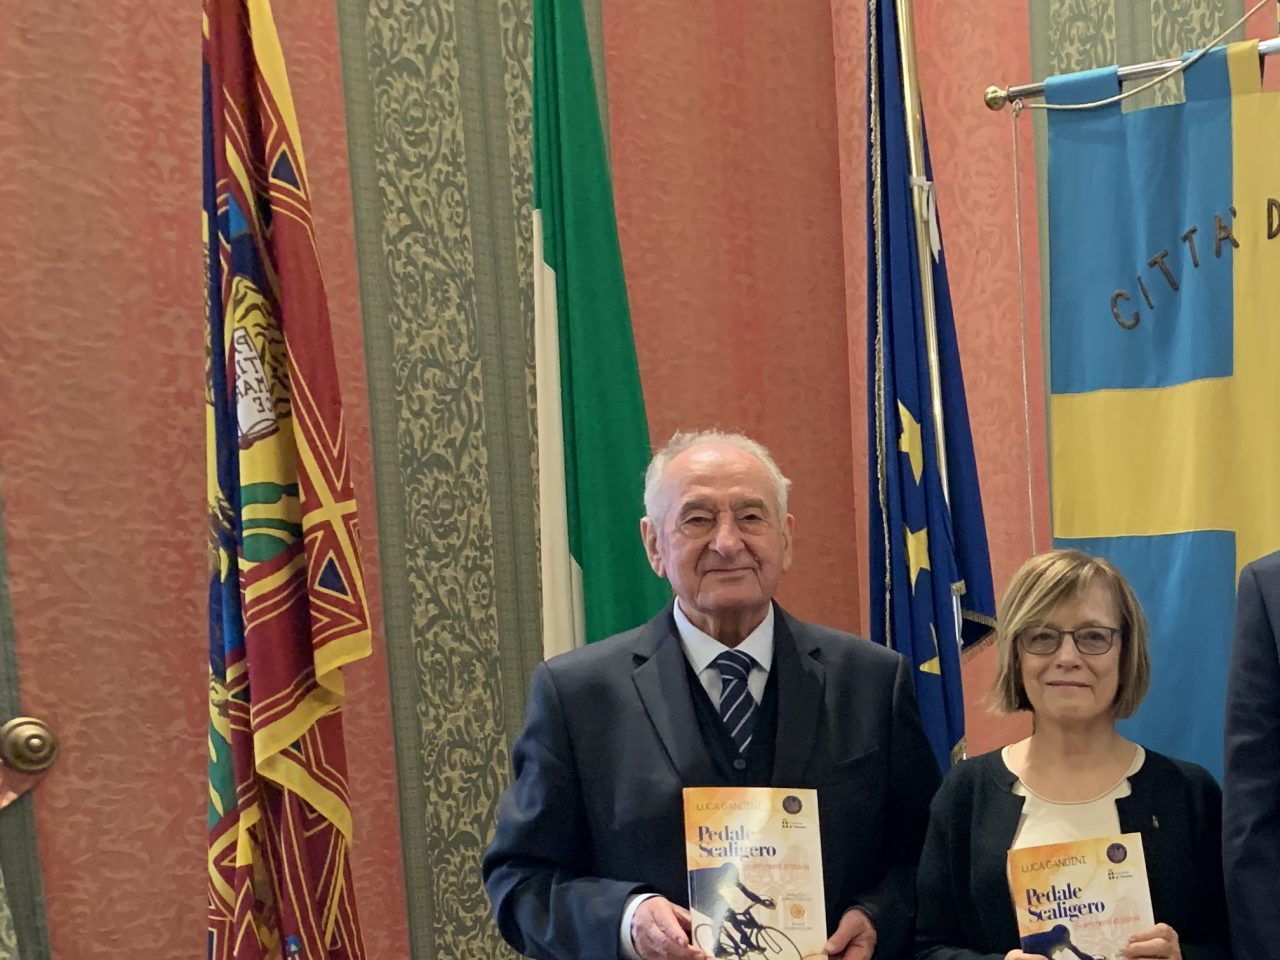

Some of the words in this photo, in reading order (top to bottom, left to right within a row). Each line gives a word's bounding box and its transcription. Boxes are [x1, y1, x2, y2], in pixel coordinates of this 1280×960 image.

[698, 842, 776, 860] Scaligero
[1025, 883, 1083, 905] Pedale
[1027, 901, 1106, 923] Scaligero
